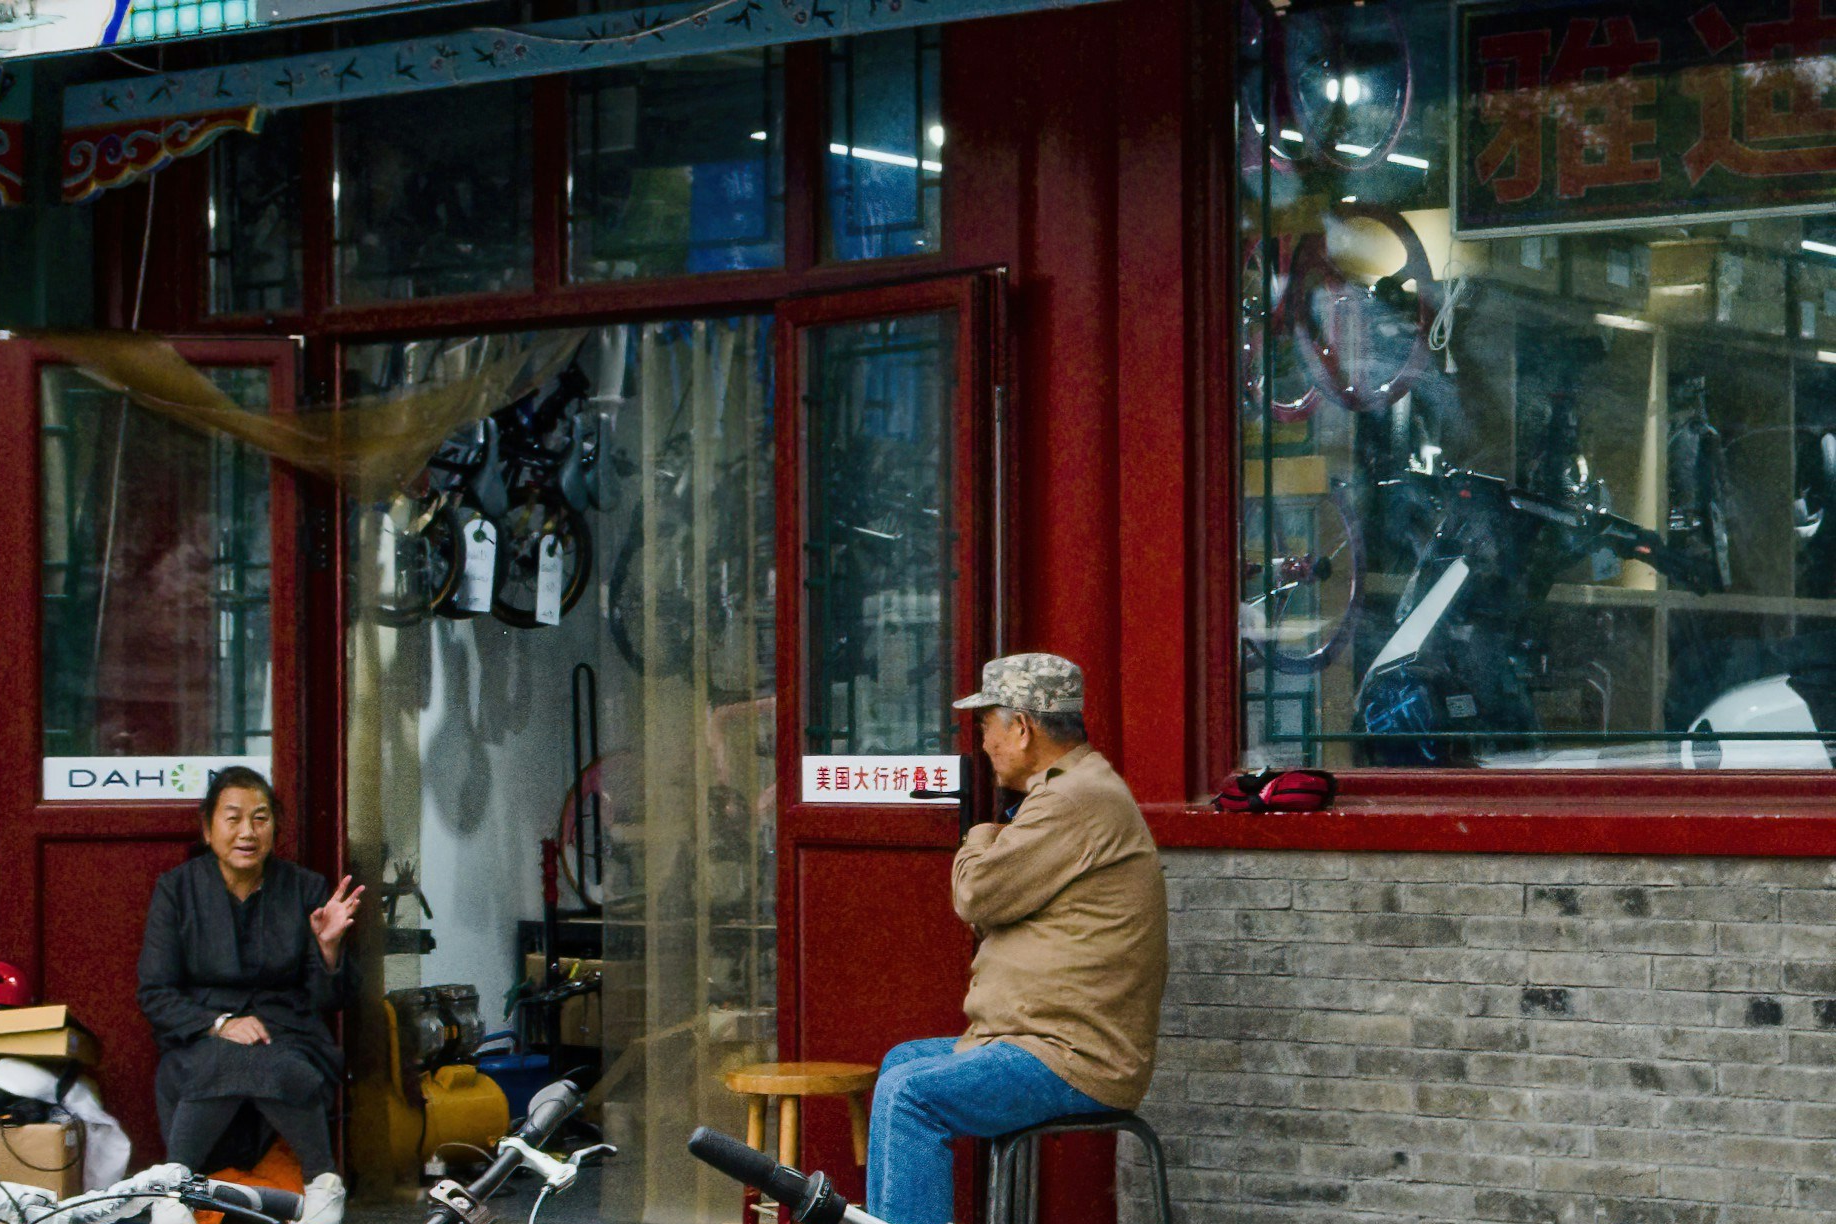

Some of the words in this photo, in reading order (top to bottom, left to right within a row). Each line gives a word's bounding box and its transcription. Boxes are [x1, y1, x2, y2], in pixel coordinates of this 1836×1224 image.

[816, 766, 948, 793] 美国大行折叠车
